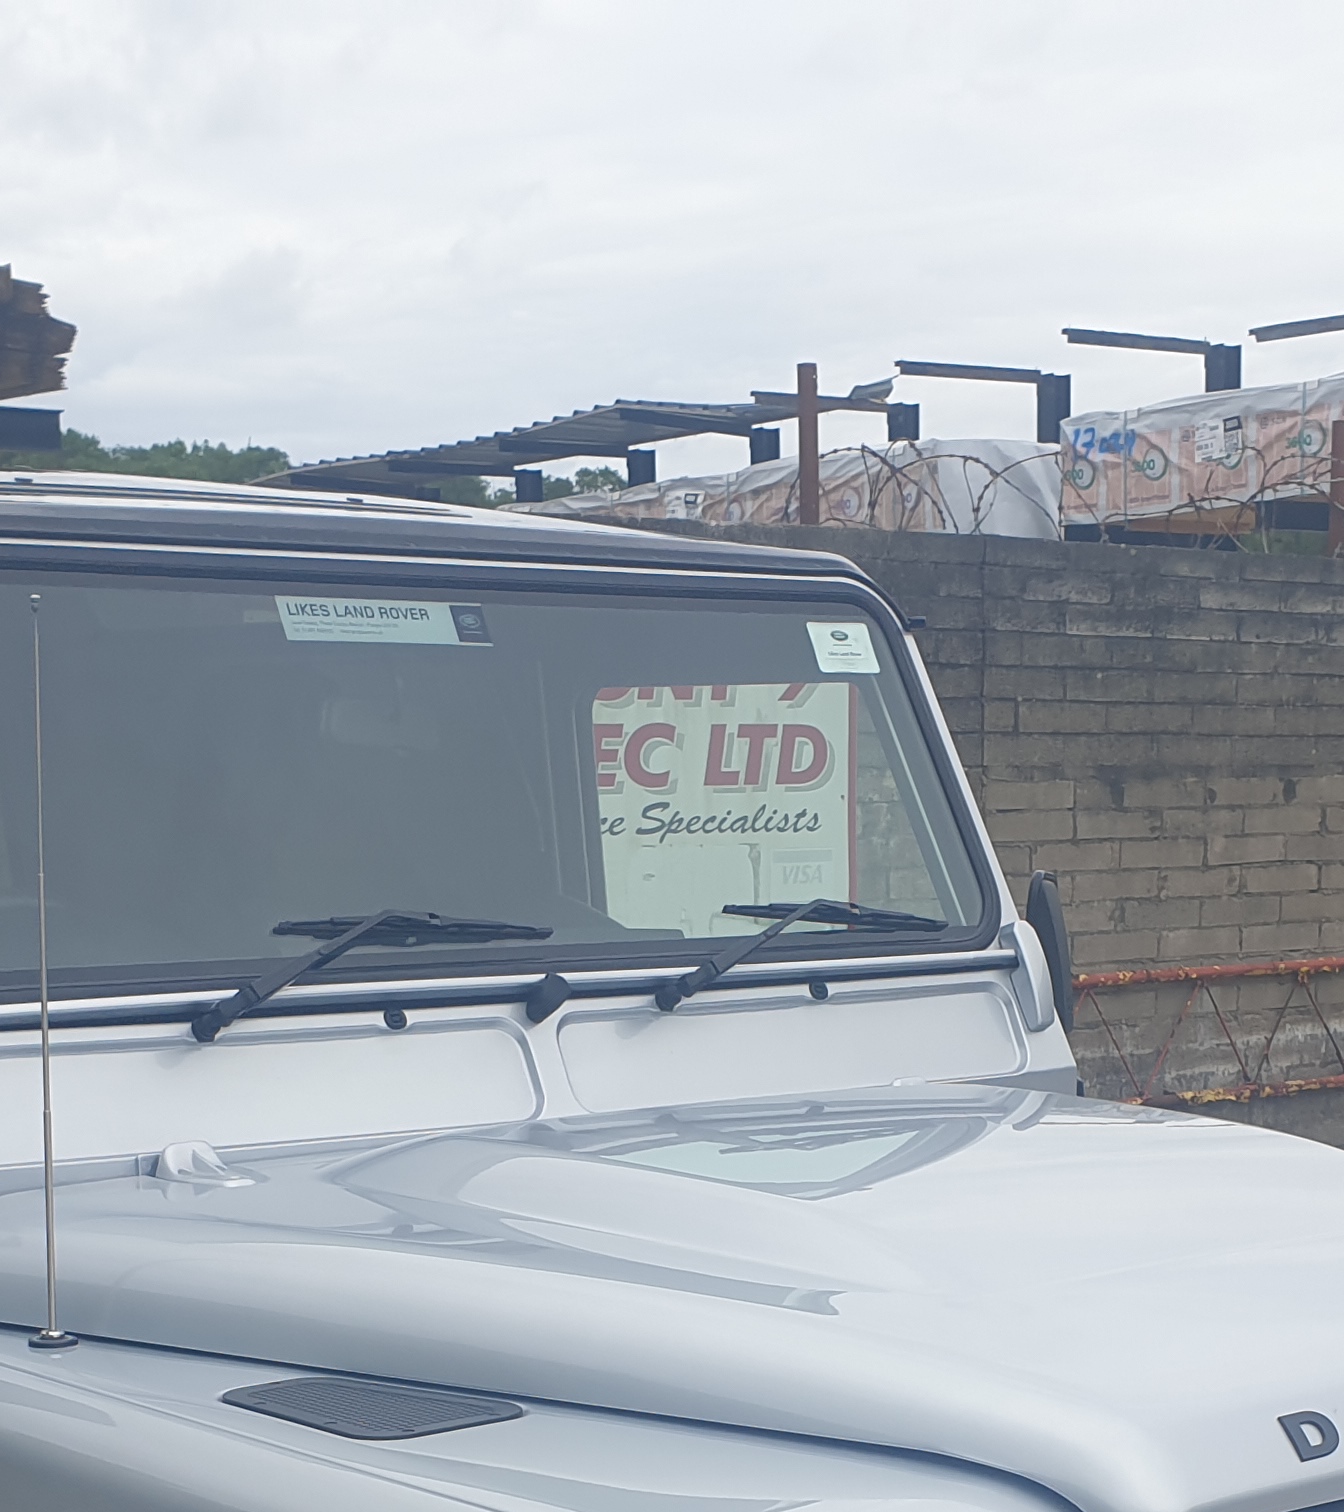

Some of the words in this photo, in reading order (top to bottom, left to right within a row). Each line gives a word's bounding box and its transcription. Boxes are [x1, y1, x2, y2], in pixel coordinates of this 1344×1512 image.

[286, 602, 331, 618] LIKES
[333, 604, 375, 619] LAND
[379, 606, 430, 621] ROVER
[703, 722, 831, 788] LTD
[635, 801, 823, 844] Specialists
[782, 864, 823, 885] VISA
